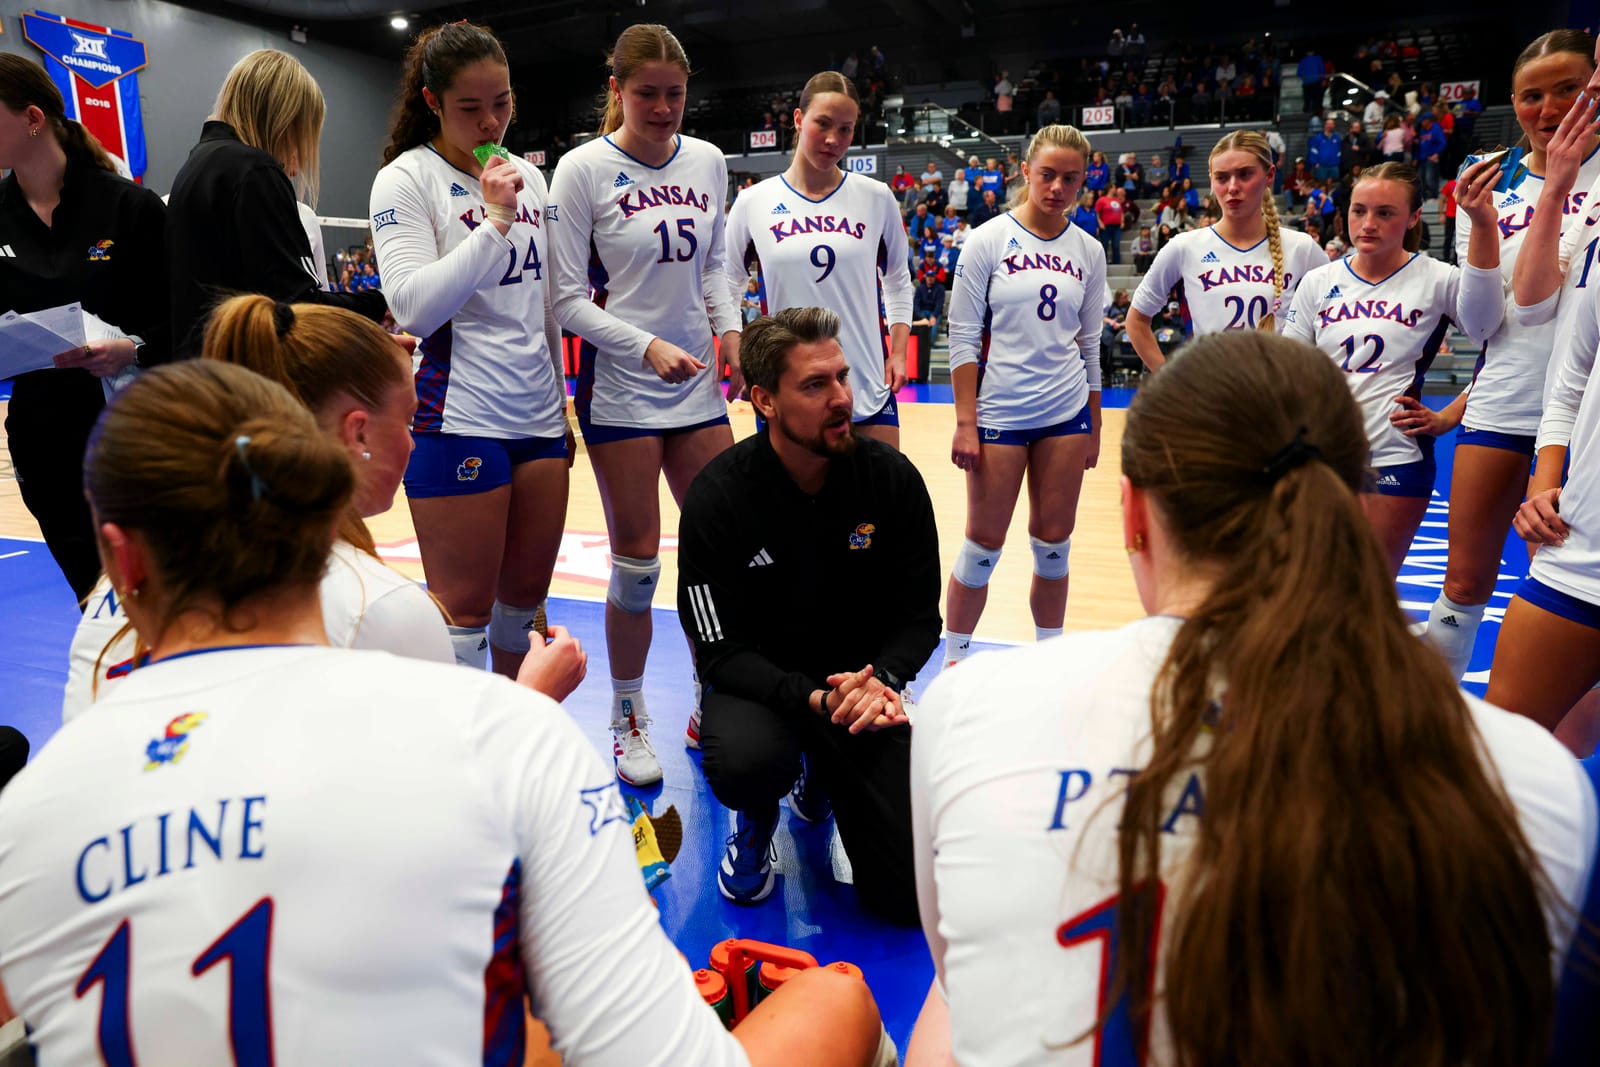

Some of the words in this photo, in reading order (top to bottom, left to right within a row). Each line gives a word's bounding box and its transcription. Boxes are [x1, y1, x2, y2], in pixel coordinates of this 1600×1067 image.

[62, 55, 122, 75] CHAMPIONS
[1084, 108, 1113, 123] 205
[752, 132, 775, 146] 204
[616, 185, 709, 219] KANSAS
[653, 218, 698, 264] 15
[769, 215, 866, 243] KANSAS
[499, 236, 542, 286] 24
[810, 244, 836, 283] 9
[1037, 284, 1058, 322] 8
[1223, 295, 1268, 331] 20
[1318, 300, 1424, 329] KANSAS
[1340, 333, 1385, 374] 12
[74, 795, 268, 904] CLINE
[75, 896, 276, 1067] 11
